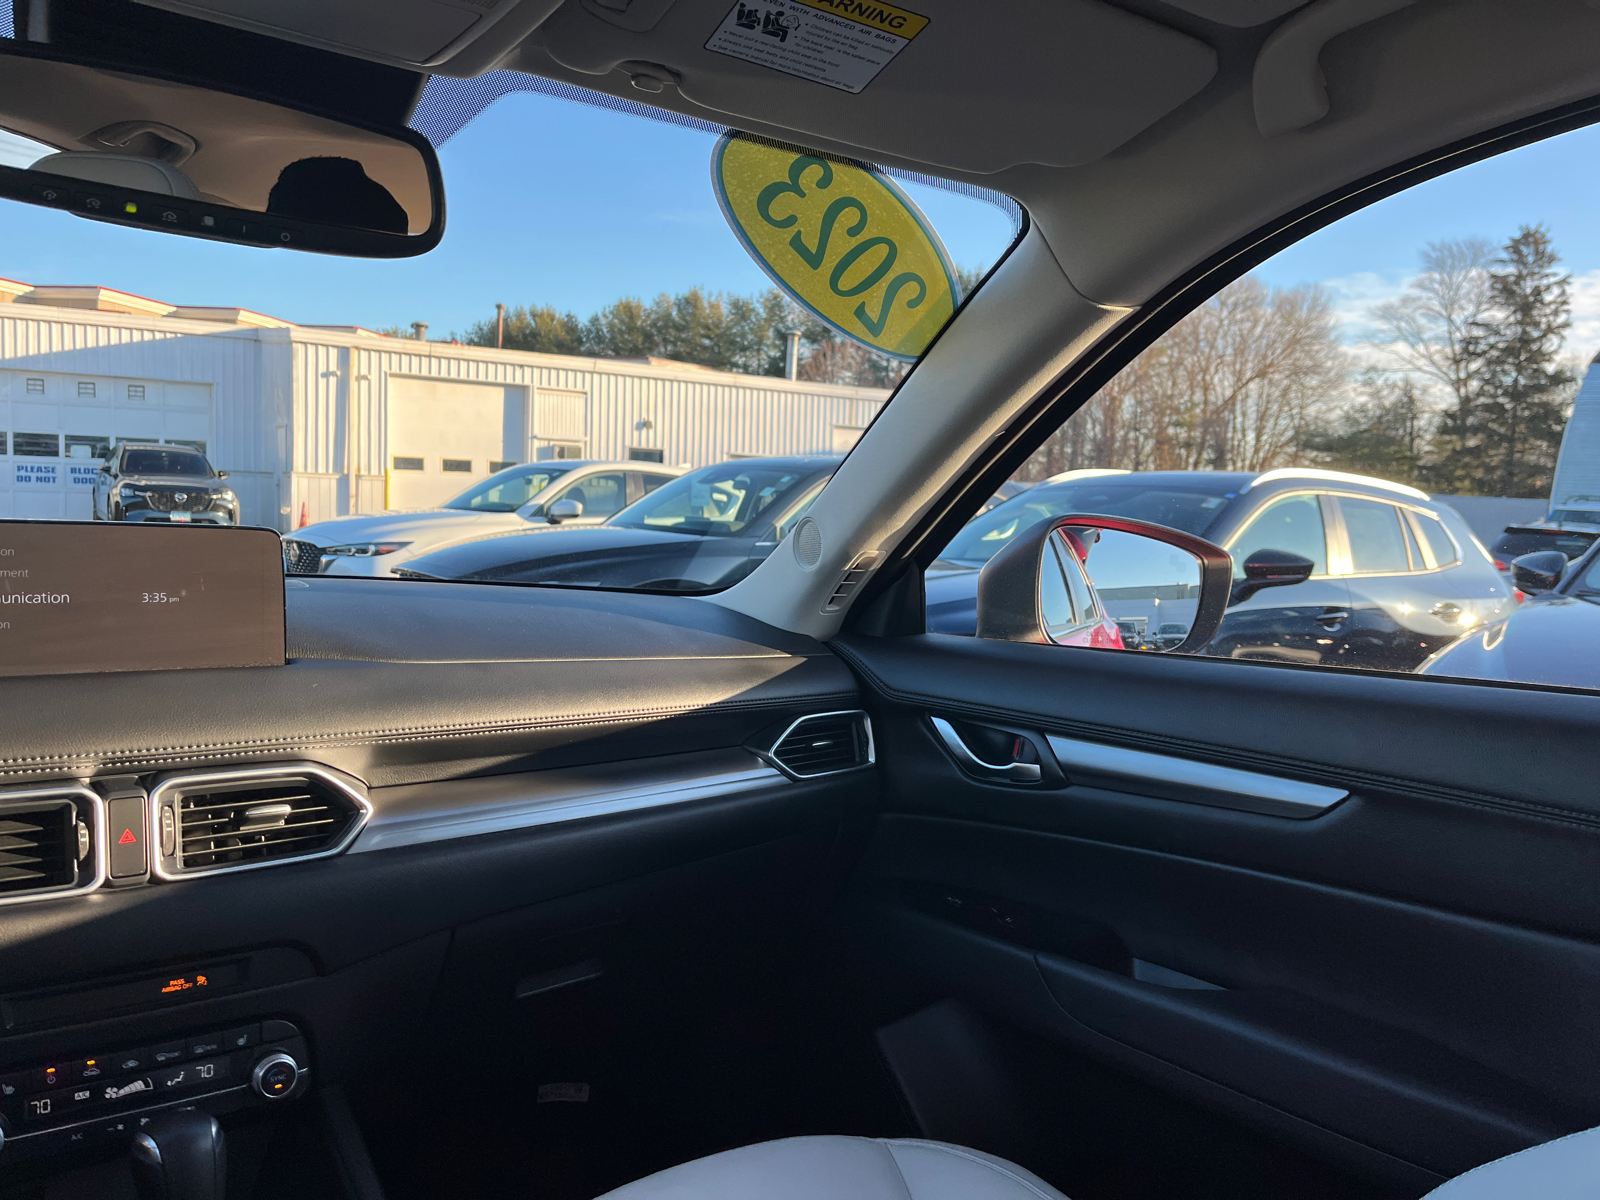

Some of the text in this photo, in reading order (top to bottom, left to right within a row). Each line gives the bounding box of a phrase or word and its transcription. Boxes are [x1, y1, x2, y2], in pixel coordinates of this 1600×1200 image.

[789, 5, 811, 15] WITH
[812, 13, 856, 30] ADVANCED
[858, 28, 873, 36] AIR
[874, 34, 897, 44] BAGS
[16, 465, 57, 474] PLEASE
[70, 467, 99, 475] BLOC
[16, 475, 57, 484] DO NOT
[0, 591, 70, 604] unication
[142, 592, 167, 603] 3:35
[169, 978, 185, 986] PASS
[195, 1064, 214, 1078] 70
[270, 1074, 287, 1082] SYNC
[30, 1099, 51, 1114] 70
